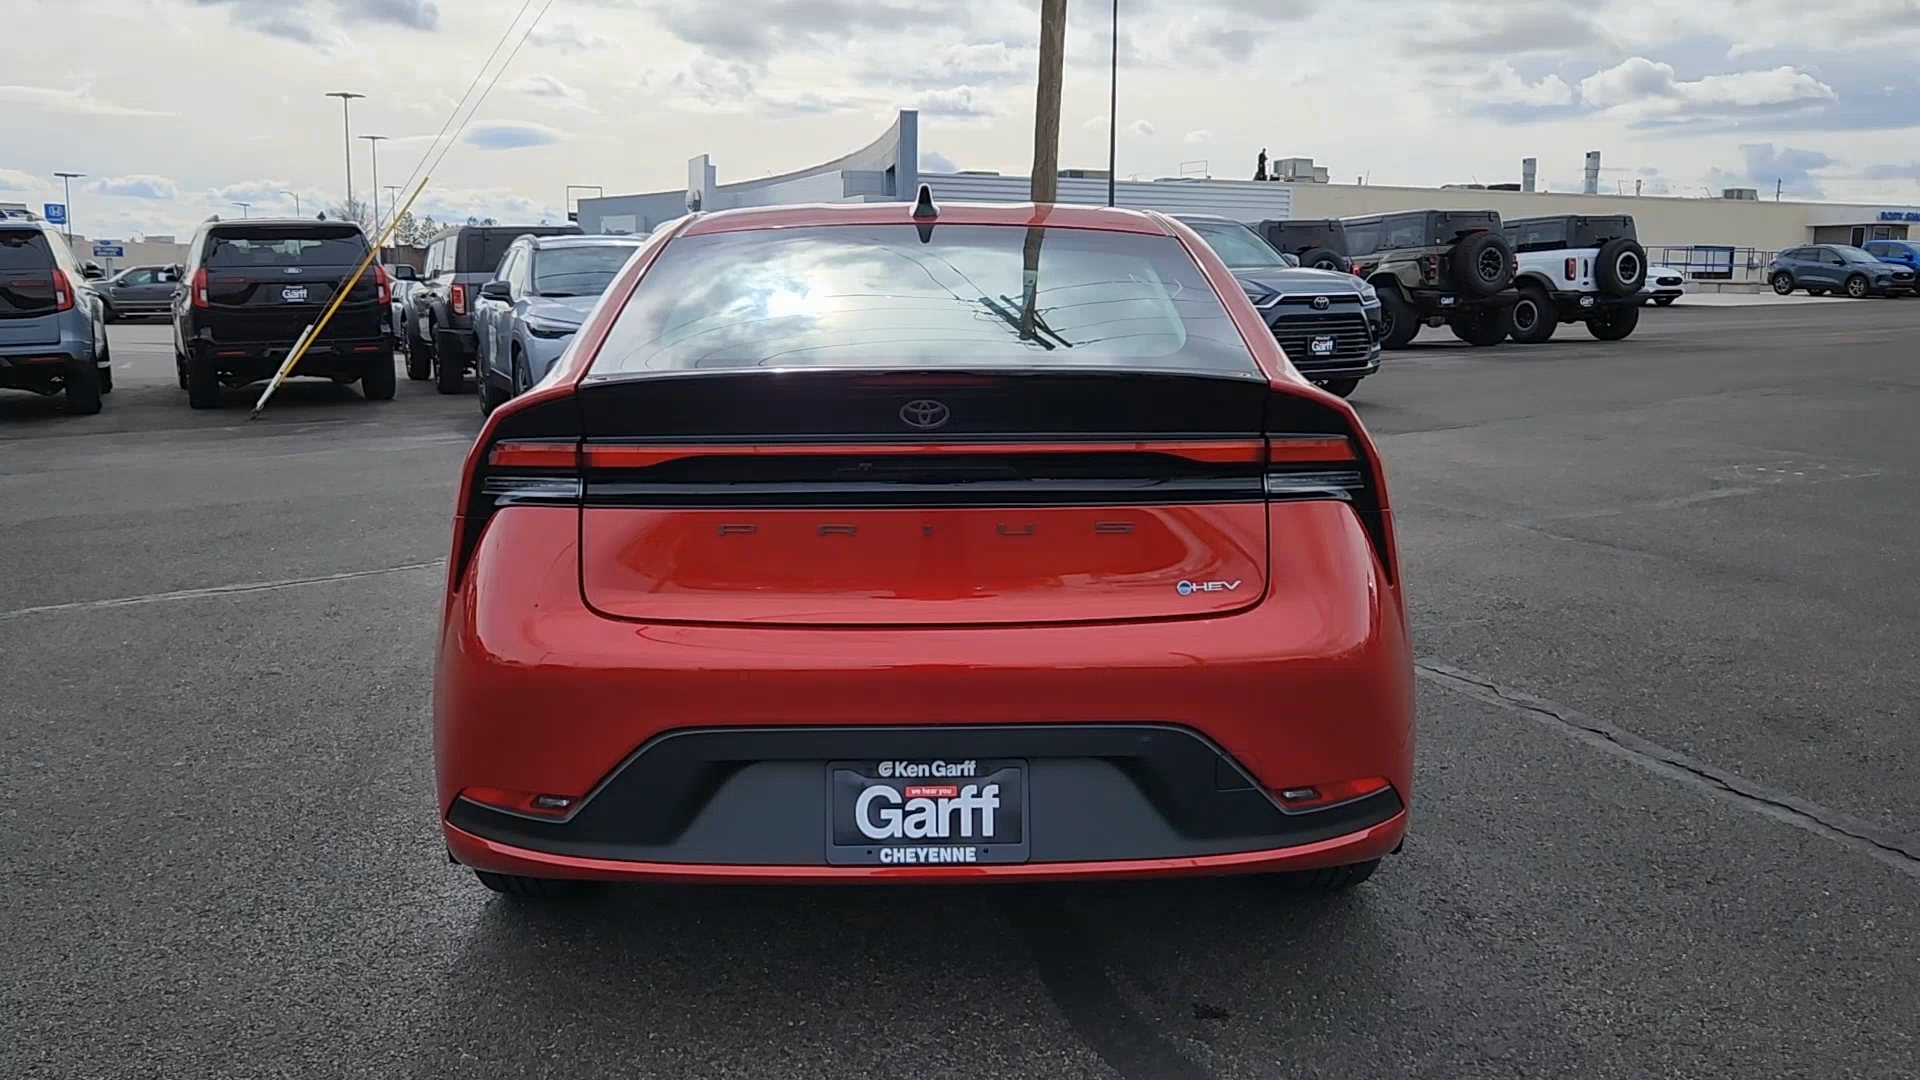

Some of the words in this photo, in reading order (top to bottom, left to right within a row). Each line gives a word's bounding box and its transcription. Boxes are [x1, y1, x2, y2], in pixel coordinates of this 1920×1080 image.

[281, 288, 308, 299] Garff
[1311, 340, 1334, 351] Garff
[716, 520, 1136, 537] PRIUS
[894, 760, 930, 777] Ken
[931, 760, 977, 777] Garff
[922, 787, 938, 795] hear
[939, 788, 952, 796] you
[855, 784, 1000, 840] Garff
[879, 847, 976, 863] CHEYENNE
